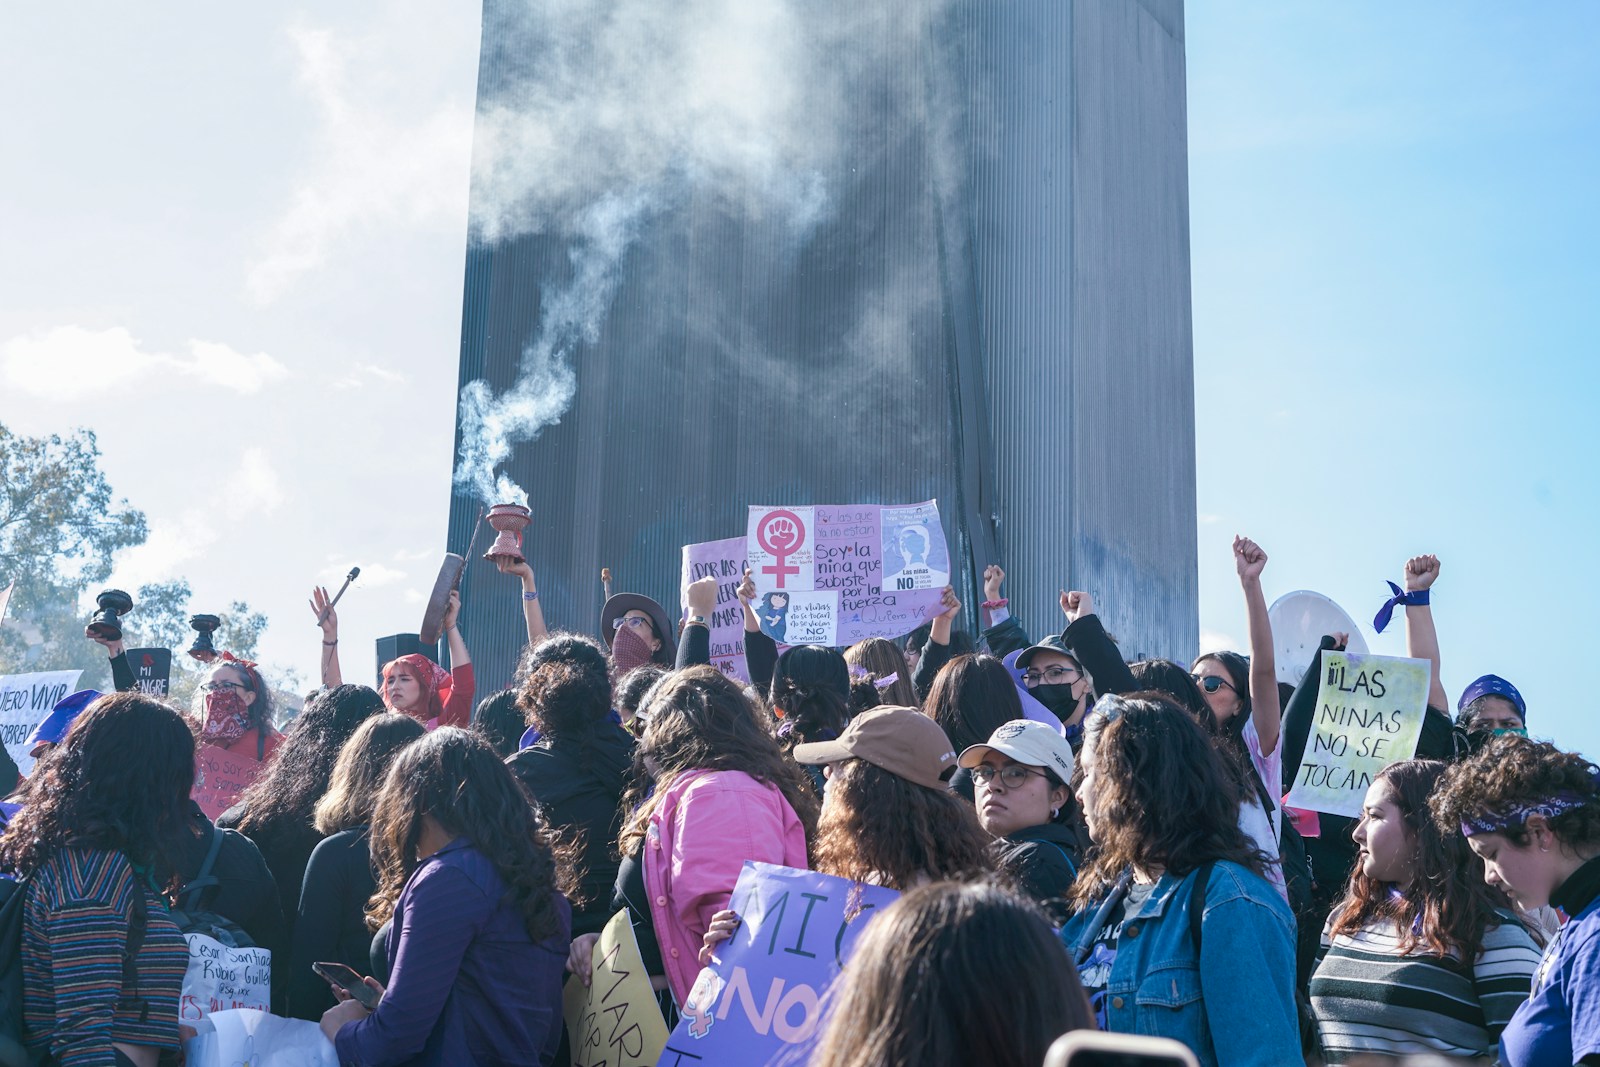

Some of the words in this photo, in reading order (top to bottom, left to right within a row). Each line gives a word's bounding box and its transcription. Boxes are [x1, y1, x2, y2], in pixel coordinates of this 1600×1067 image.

[817, 509, 832, 523] Por
[837, 509, 852, 523] las
[855, 511, 873, 523] que
[830, 527, 842, 538] no
[815, 543, 848, 560] Soy
[854, 541, 871, 557] la
[858, 559, 881, 577] que
[815, 572, 867, 589] subiste
[896, 577, 914, 590] NO
[841, 587, 862, 598] por
[867, 583, 881, 596] la
[841, 595, 896, 611] fuerza
[711, 642, 734, 656] FALTA
[140, 666, 152, 677] MI
[139, 678, 167, 697] NGRE
[1319, 703, 1401, 734] NINAS
[1313, 732, 1348, 757] NO
[1356, 736, 1391, 759] SE
[728, 883, 829, 959] MI
[188, 934, 220, 959] Cesar
[203, 959, 236, 981] Rubio
[181, 994, 203, 1021] ES
[715, 965, 820, 1044] NO
